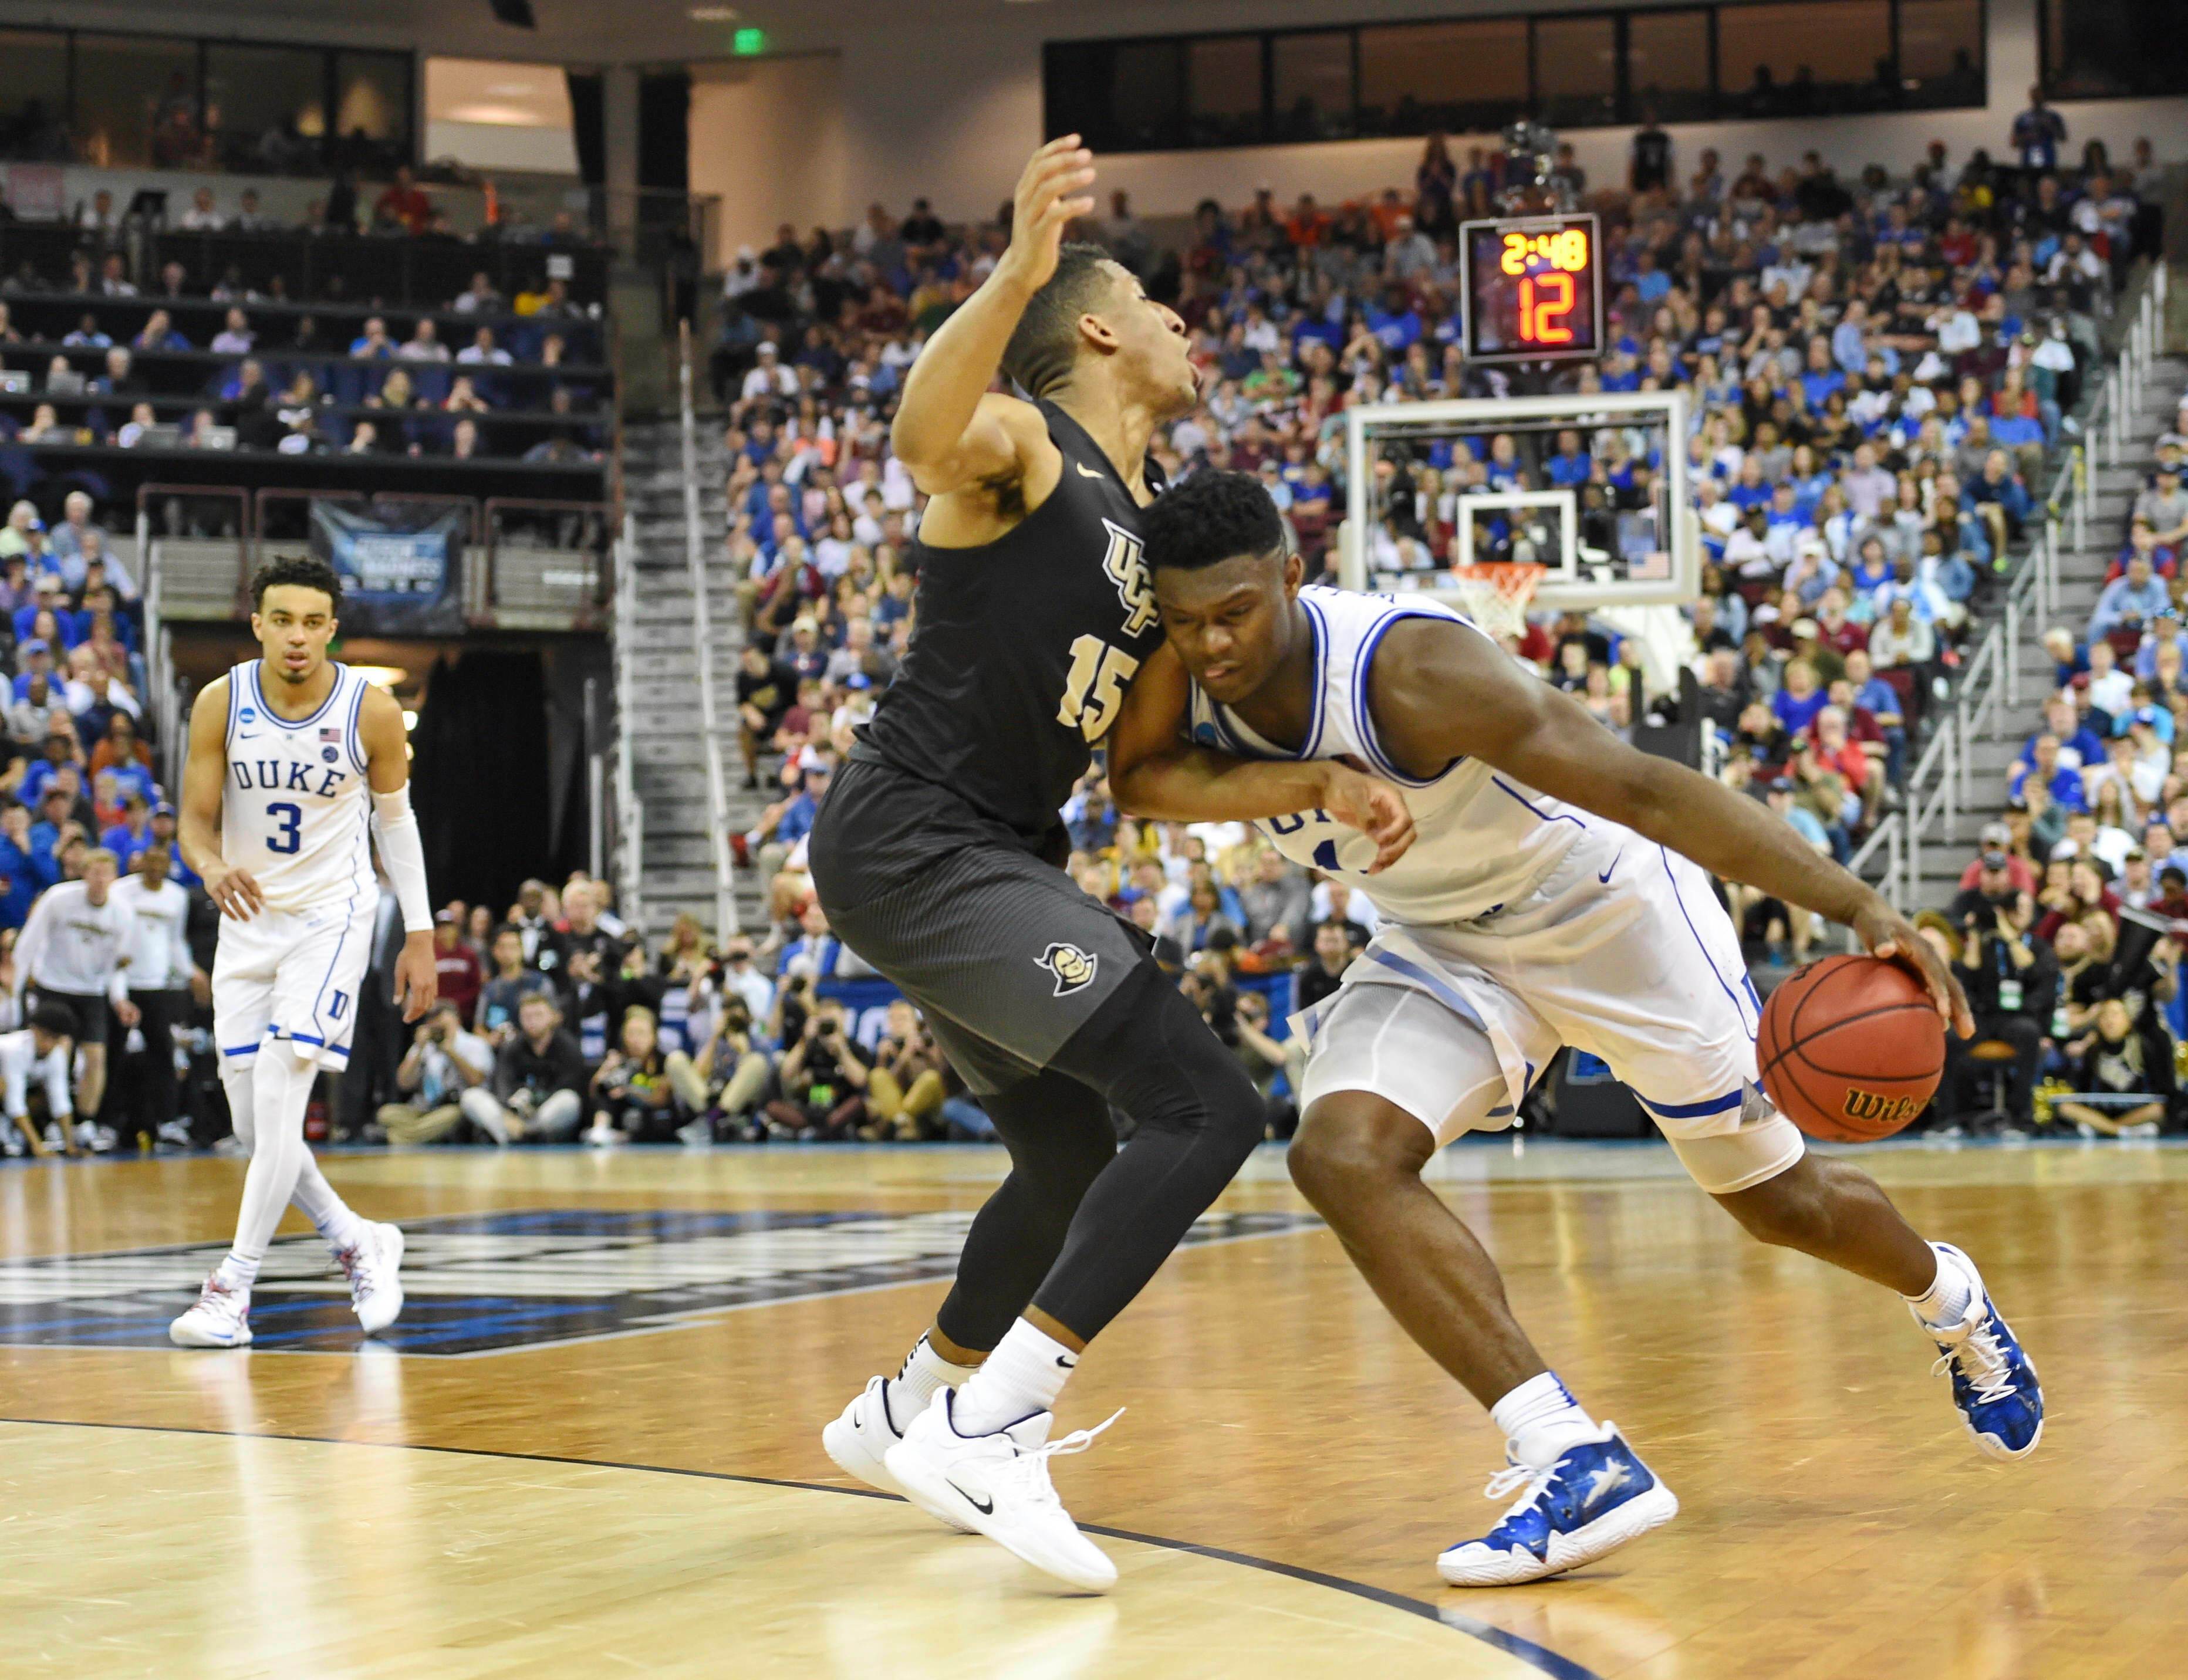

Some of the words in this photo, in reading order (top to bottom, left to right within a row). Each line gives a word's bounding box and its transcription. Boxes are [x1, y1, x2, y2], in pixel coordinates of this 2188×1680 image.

[1501, 229, 1587, 275] 2:48
[1518, 272, 1576, 343] 12
[1056, 633, 1139, 743] 15
[232, 760, 346, 798] DUKE
[266, 802, 301, 854] 3
[328, 989, 349, 1020] D
[1843, 1087, 1928, 1123] Wils
